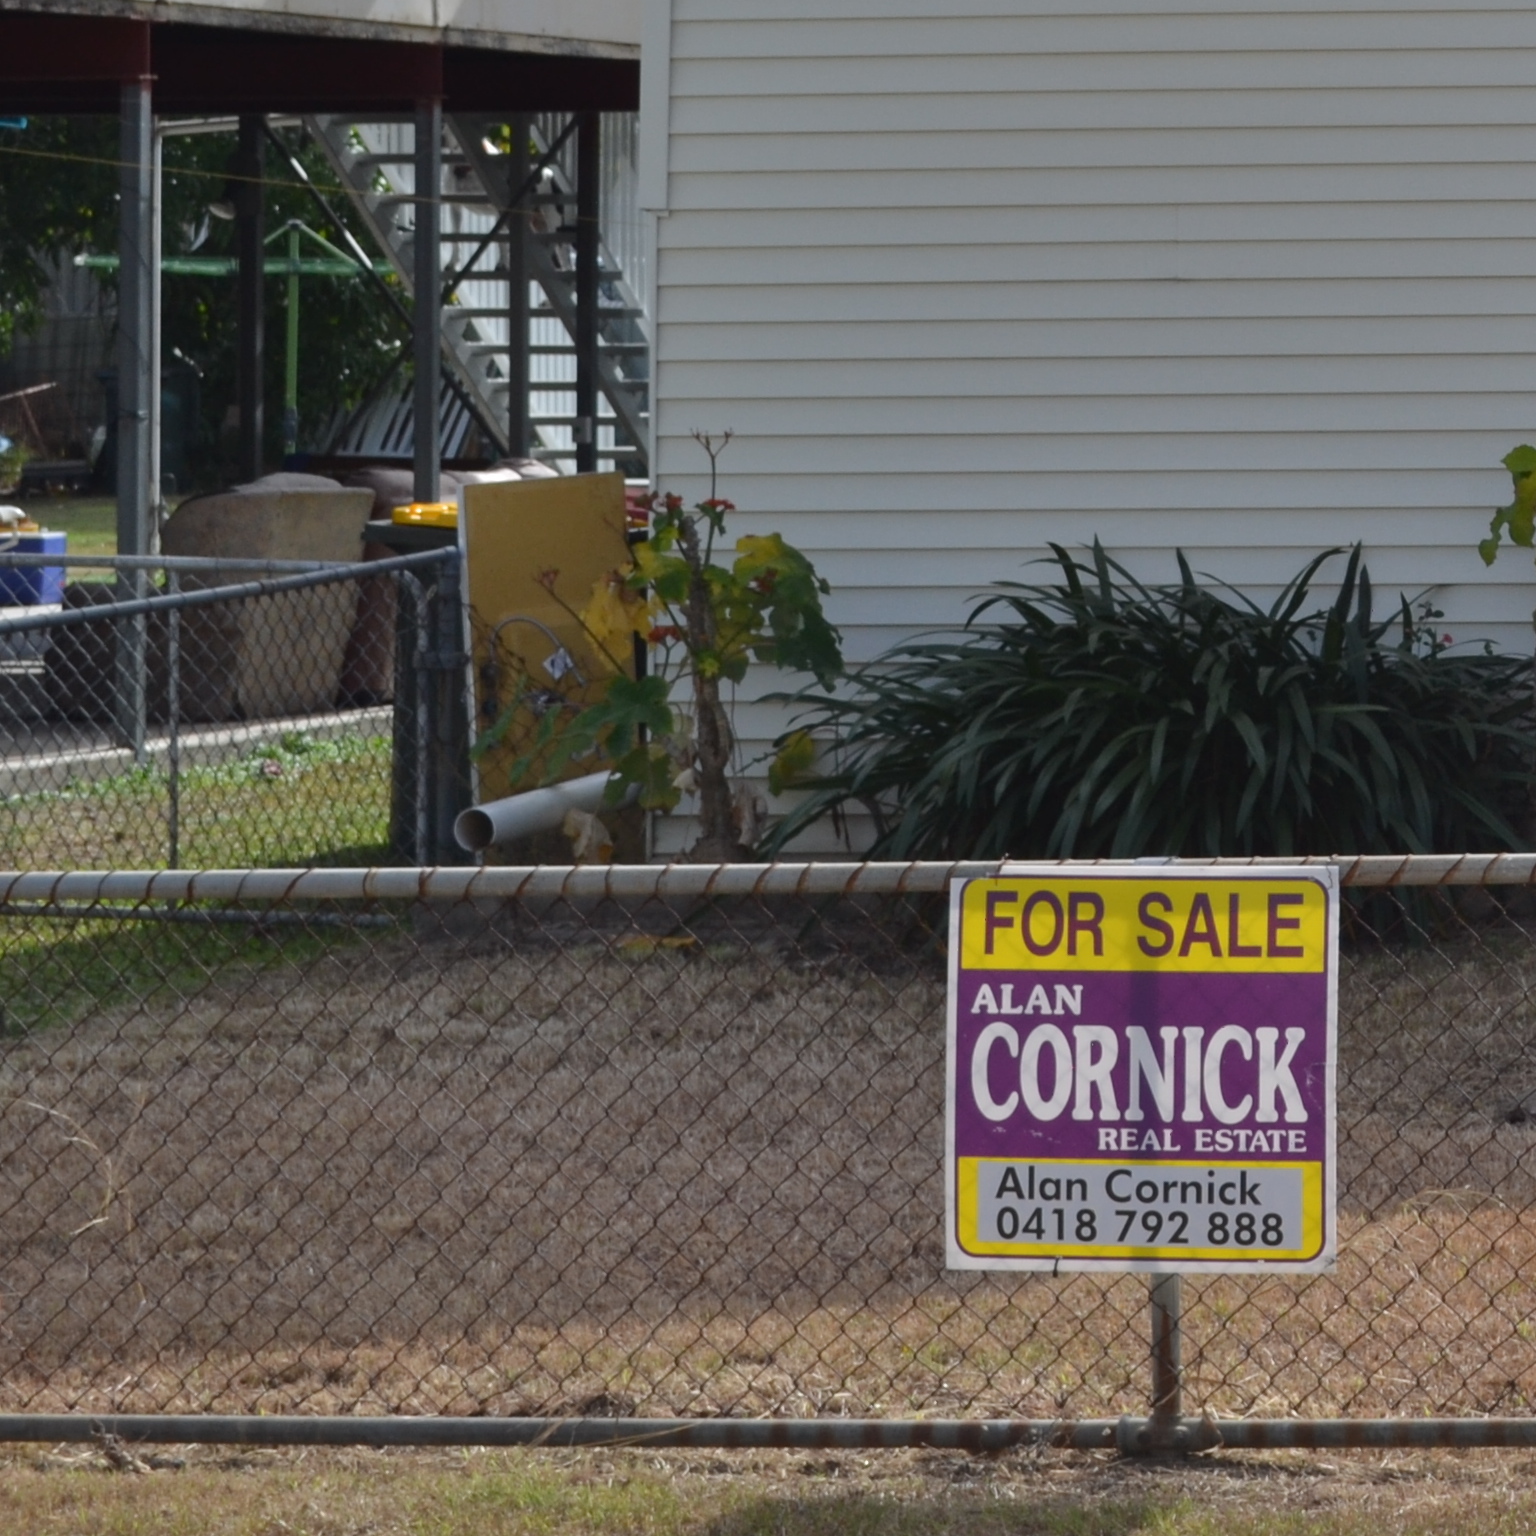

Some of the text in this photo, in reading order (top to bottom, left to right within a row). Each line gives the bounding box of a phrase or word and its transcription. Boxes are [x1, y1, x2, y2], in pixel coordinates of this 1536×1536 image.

[983, 890, 1305, 958] FOR SALE
[971, 984, 1083, 1015] ALAN
[971, 1021, 1308, 1124] CORNICK
[1098, 1128, 1307, 1153] REAL ESTATE
[995, 1166, 1262, 1206] Alan Cornick
[996, 1206, 1284, 1246] 0418 792 888
